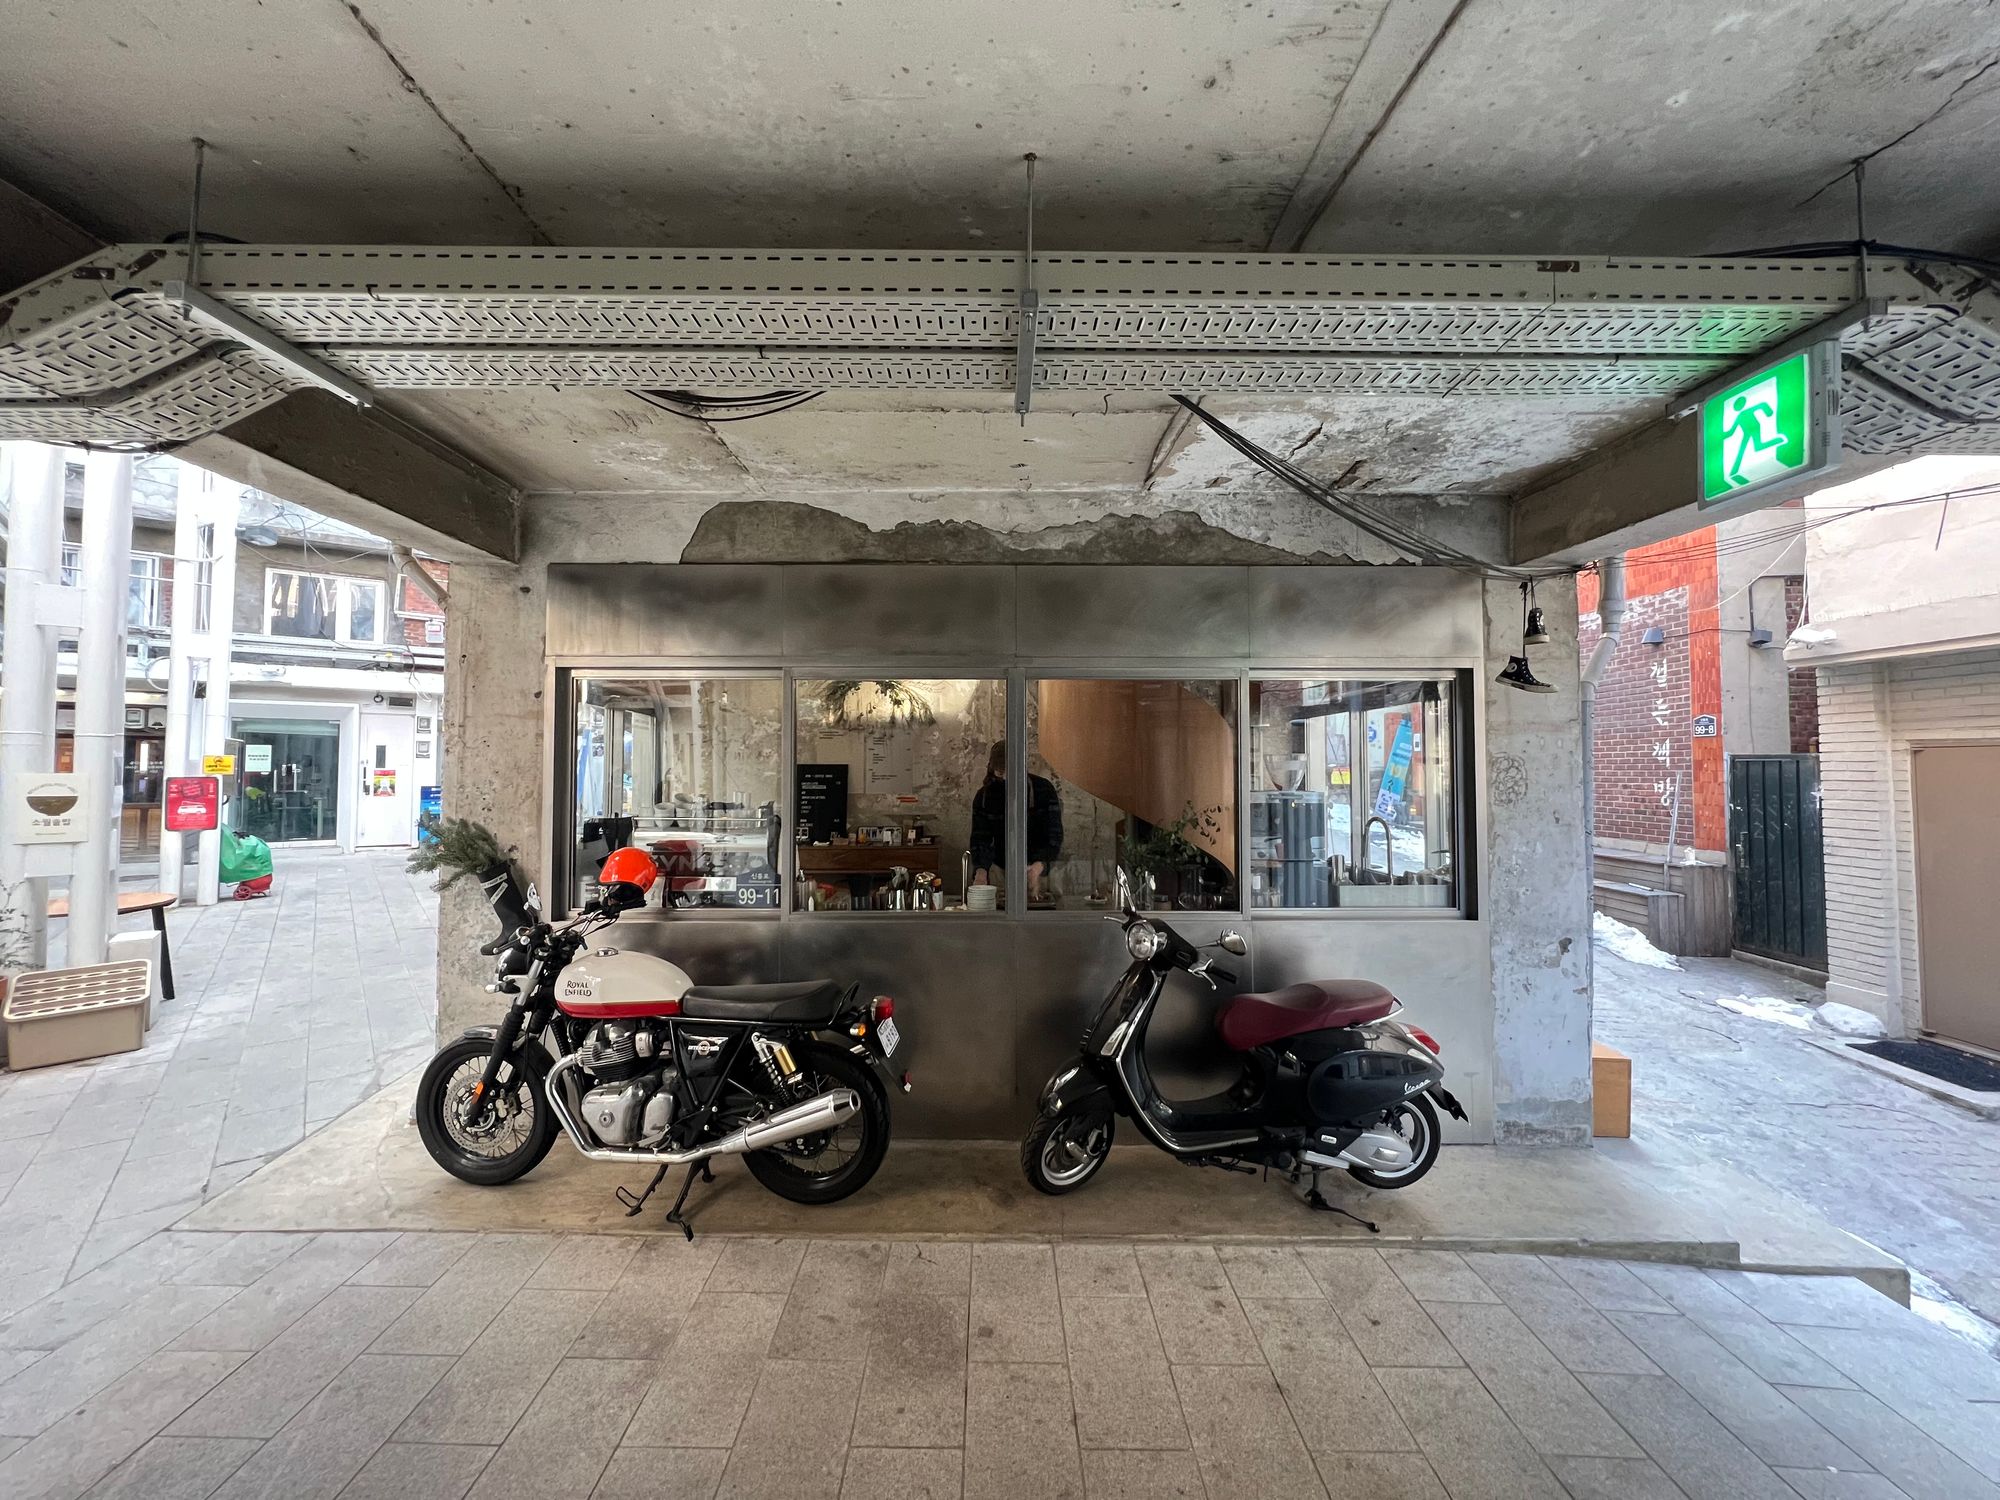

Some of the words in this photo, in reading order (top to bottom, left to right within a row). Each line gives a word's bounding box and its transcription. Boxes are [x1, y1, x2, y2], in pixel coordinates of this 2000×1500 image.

[1695, 725, 1714, 735] 99-8
[738, 888, 779, 905] 99-11
[567, 980, 589, 988] ROYAL
[565, 989, 592, 997] ENFIELD
